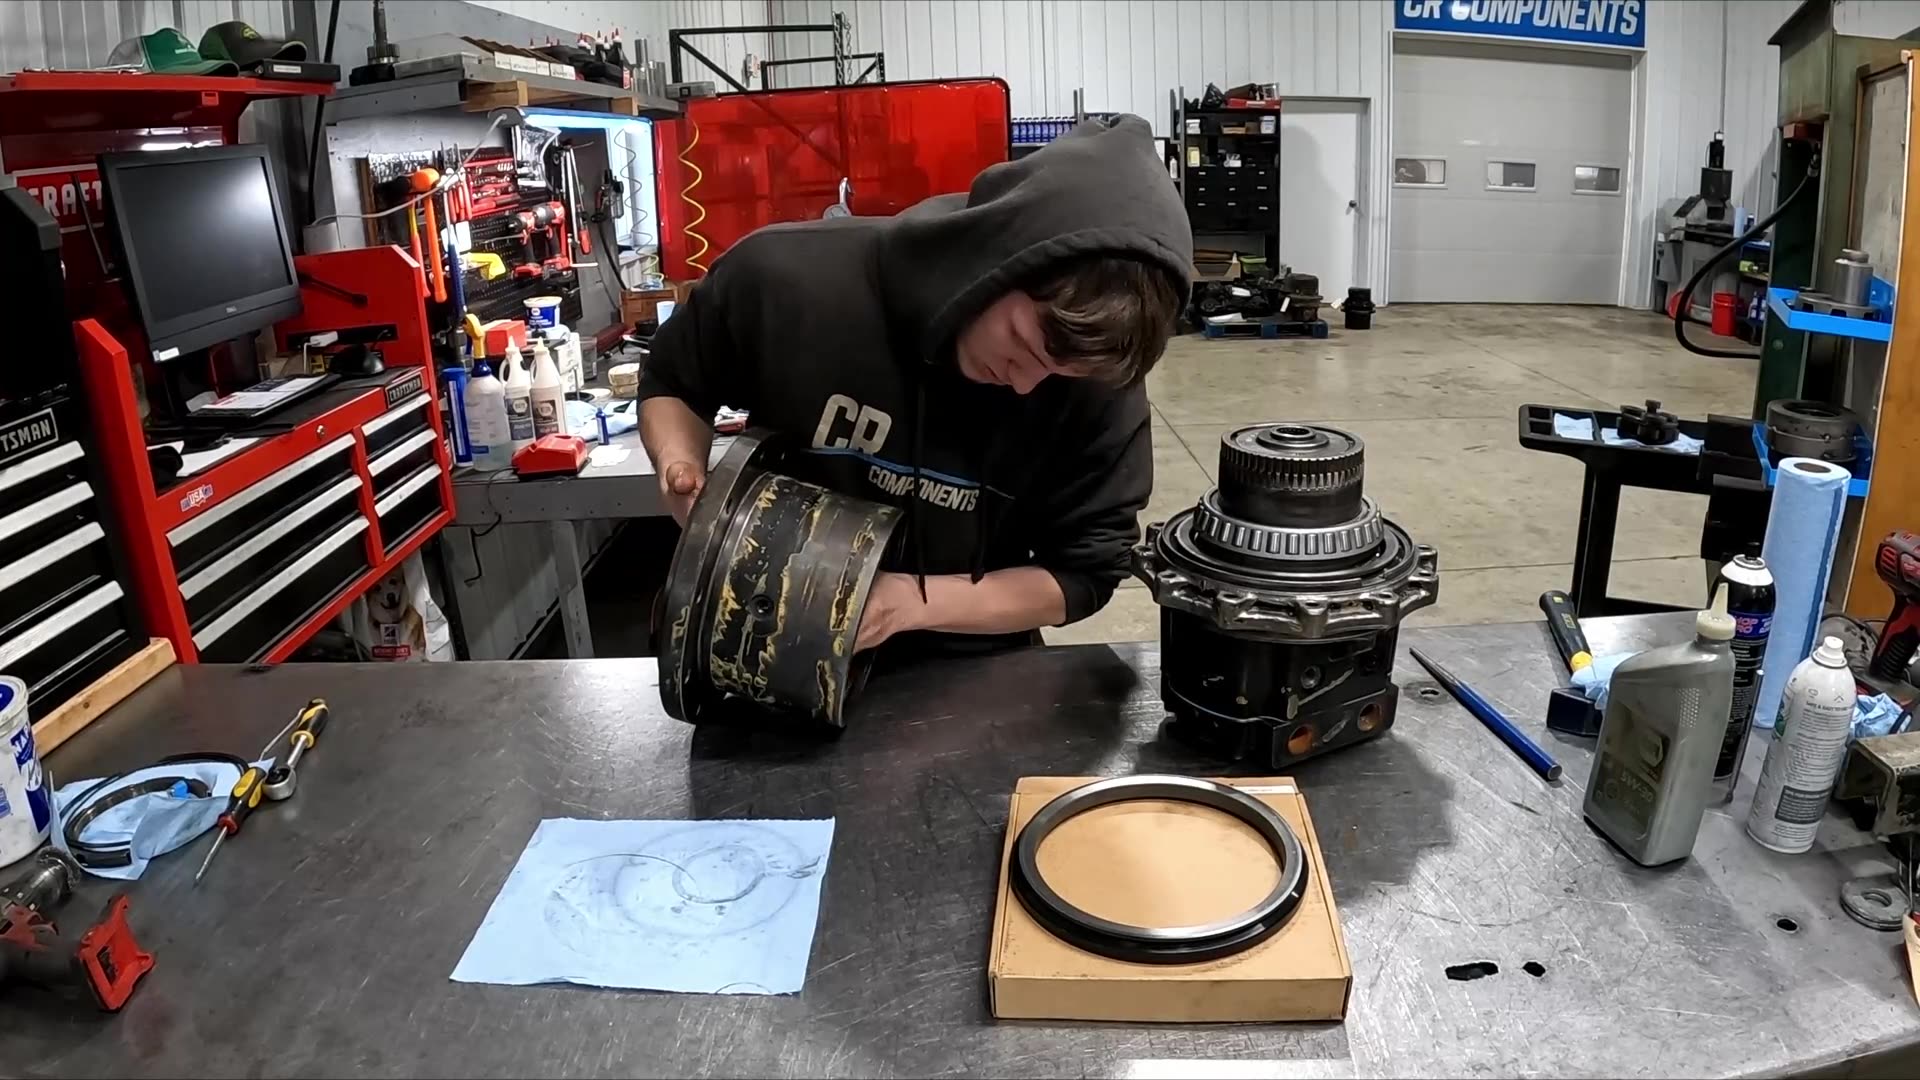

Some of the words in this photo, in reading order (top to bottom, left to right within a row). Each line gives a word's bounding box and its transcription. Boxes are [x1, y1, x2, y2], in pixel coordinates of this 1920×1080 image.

[1451, 0, 1640, 36] COMPONENTS
[0, 419, 51, 452] TSMAN
[812, 393, 892, 455] CR
[868, 465, 980, 511] COMPONENTS
